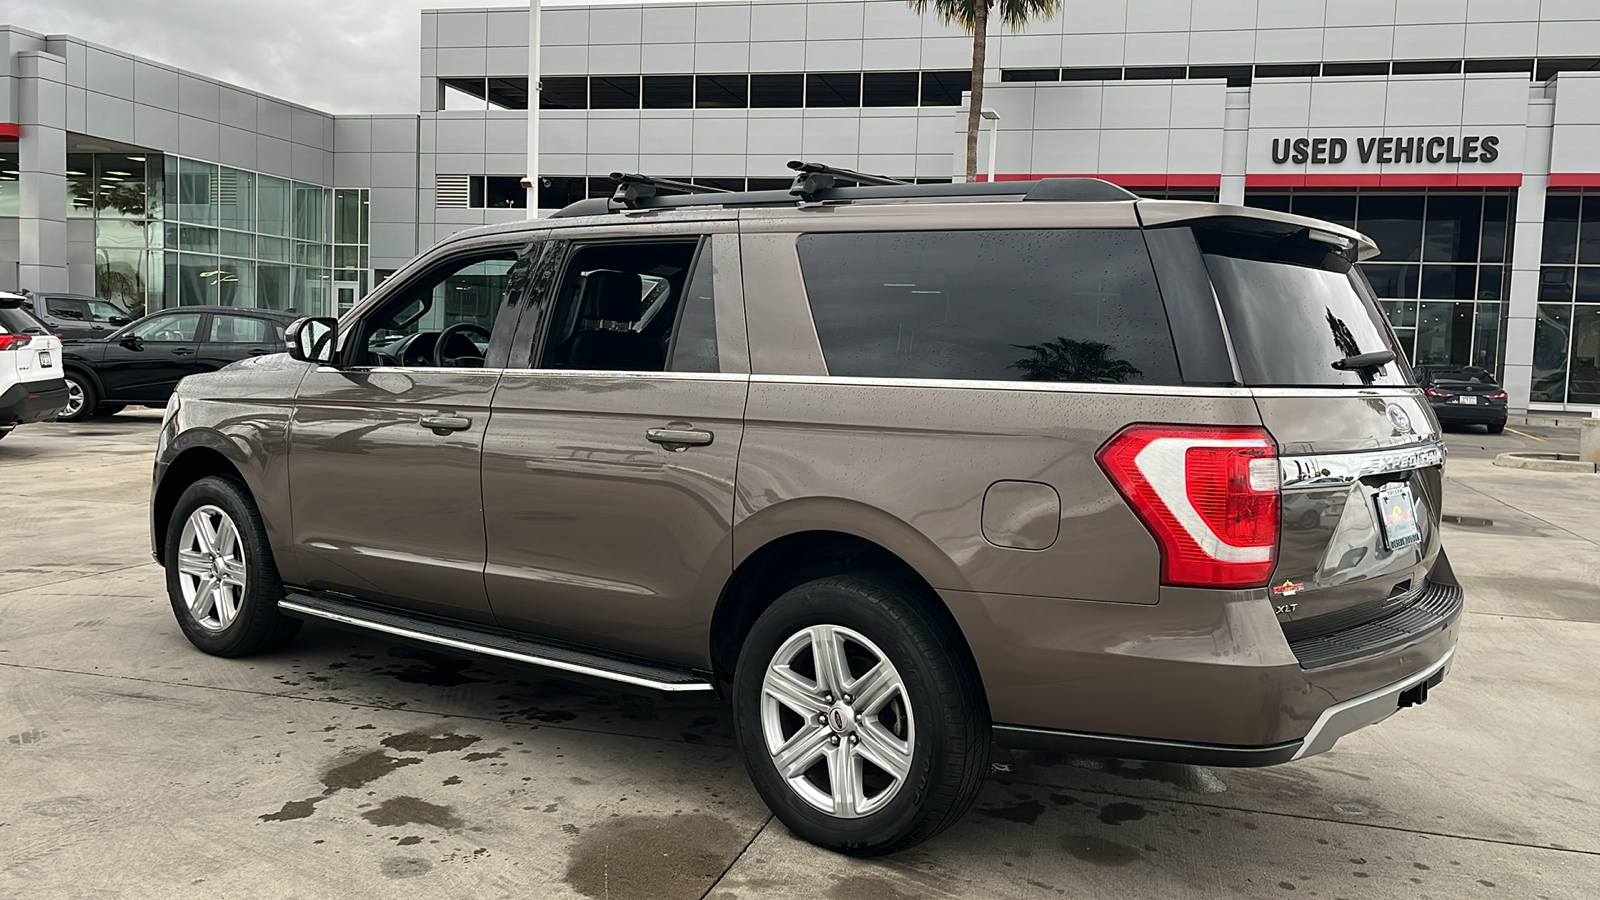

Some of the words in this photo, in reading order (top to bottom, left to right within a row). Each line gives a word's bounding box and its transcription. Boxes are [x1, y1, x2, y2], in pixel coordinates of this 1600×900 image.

[1272, 138, 1348, 165] USED
[1357, 136, 1500, 164] VEHICLES
[1275, 603, 1298, 615] XLT
